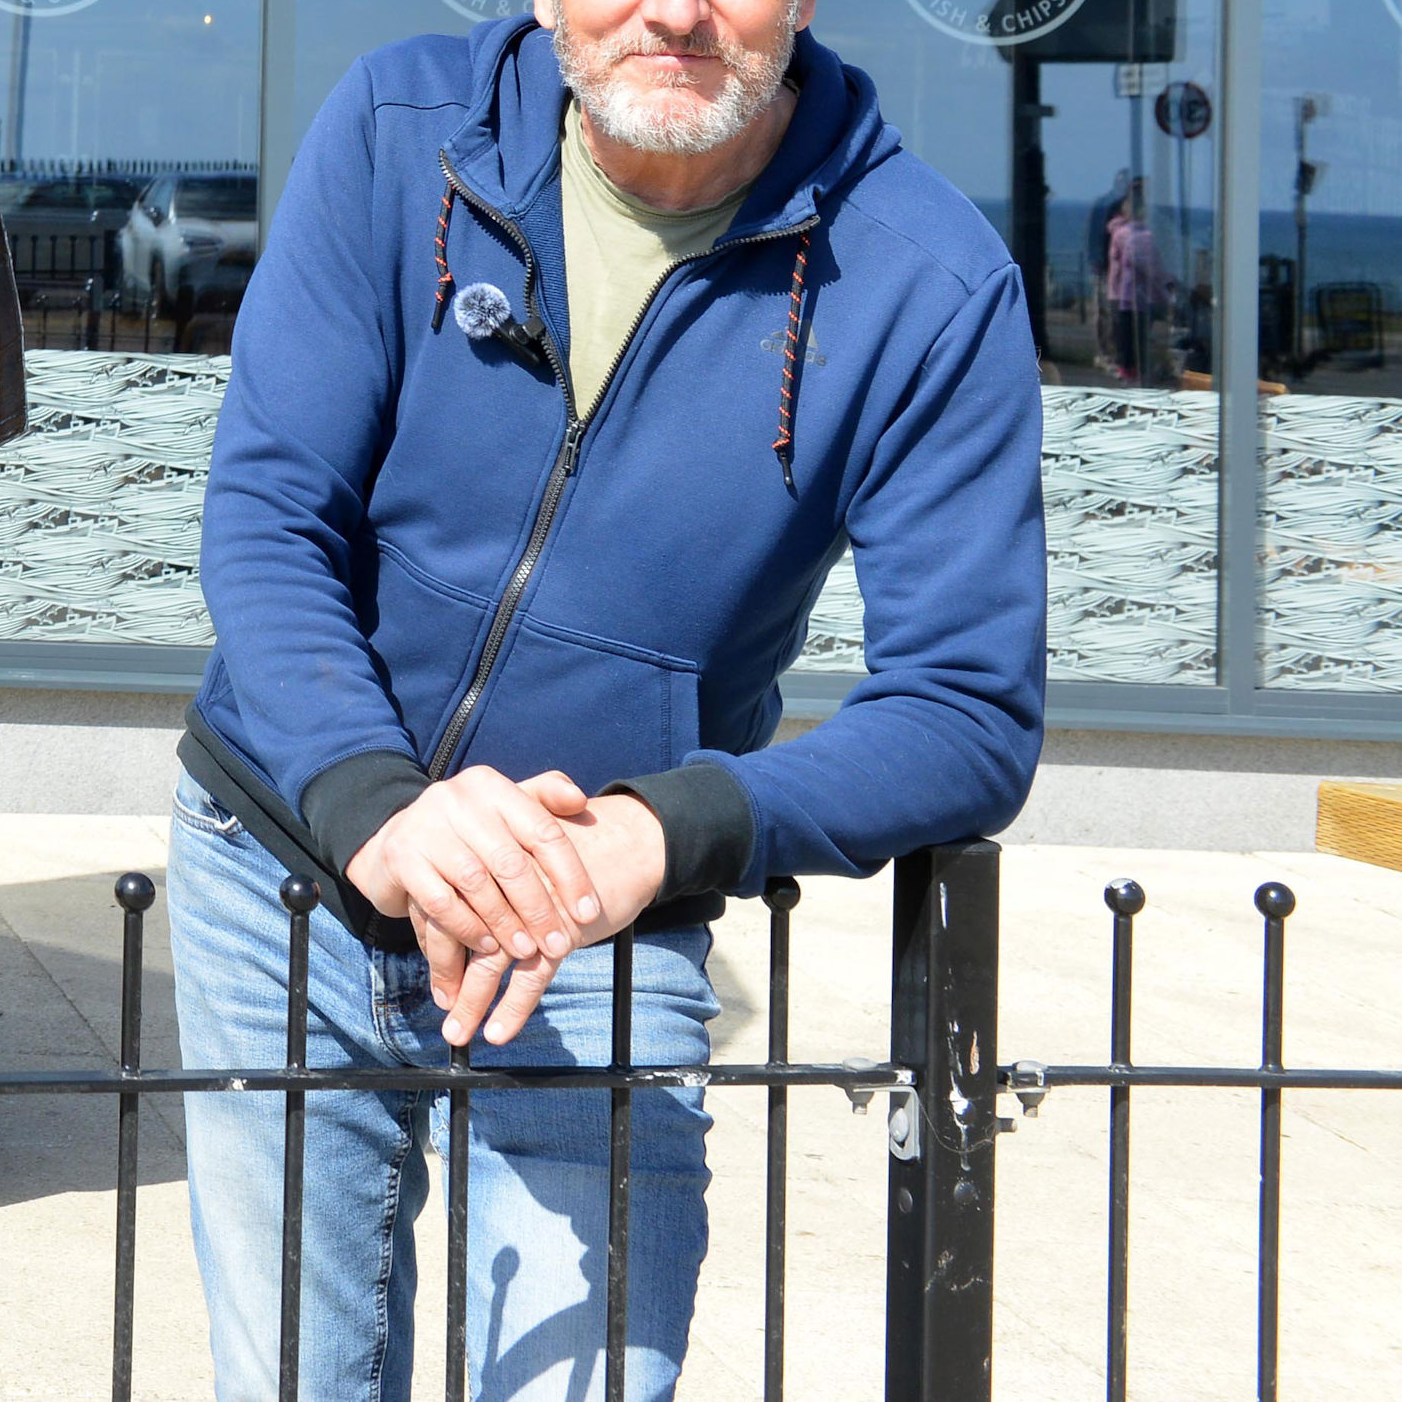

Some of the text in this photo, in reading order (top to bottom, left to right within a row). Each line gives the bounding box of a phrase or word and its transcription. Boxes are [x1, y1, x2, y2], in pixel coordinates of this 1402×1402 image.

[496, 0, 511, 16] &
[975, 13, 991, 33] &
[760, 339, 827, 366] adas
